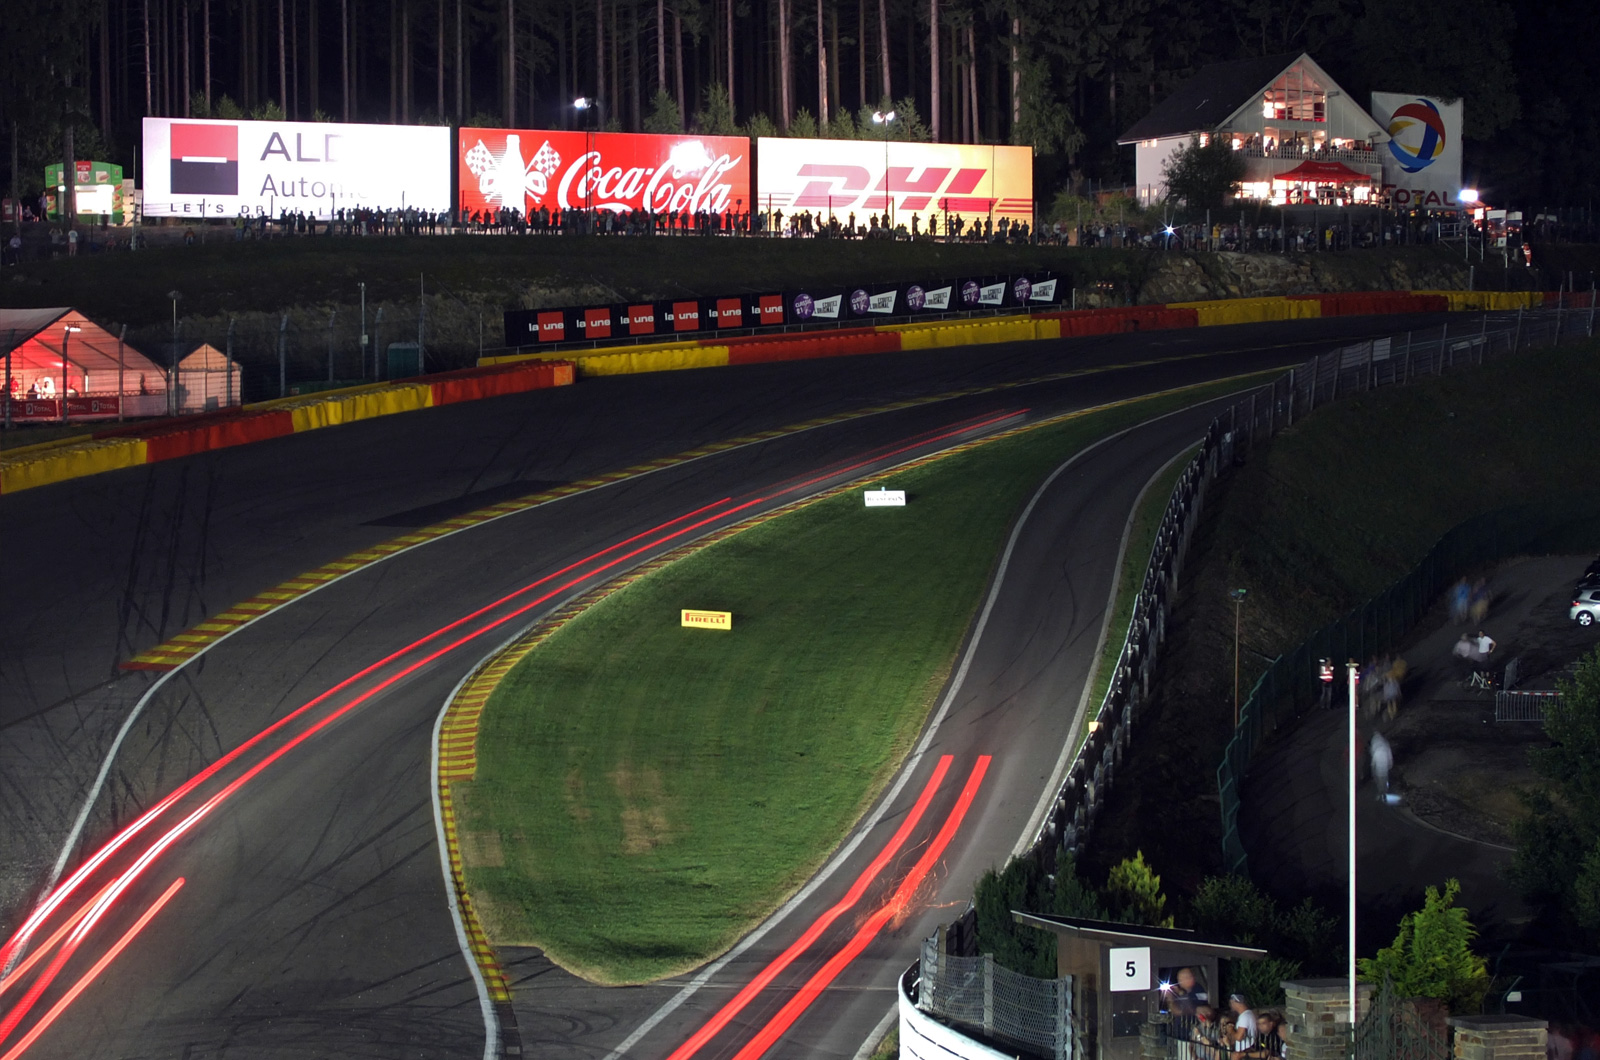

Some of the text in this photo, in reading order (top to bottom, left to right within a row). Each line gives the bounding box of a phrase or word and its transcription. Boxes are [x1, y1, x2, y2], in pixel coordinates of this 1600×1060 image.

[557, 151, 742, 215] Coca-Cola
[793, 164, 998, 212] DHL
[963, 294, 970, 302] 21
[751, 305, 783, 314] la une
[796, 307, 803, 315] 21
[853, 303, 860, 311] 21
[664, 312, 698, 321] la une
[708, 309, 741, 318] la une
[576, 319, 610, 328] la une
[620, 316, 630, 324] la
[528, 322, 564, 331] la une
[685, 612, 725, 624] PIRELLI
[1126, 961, 1136, 977] 5
